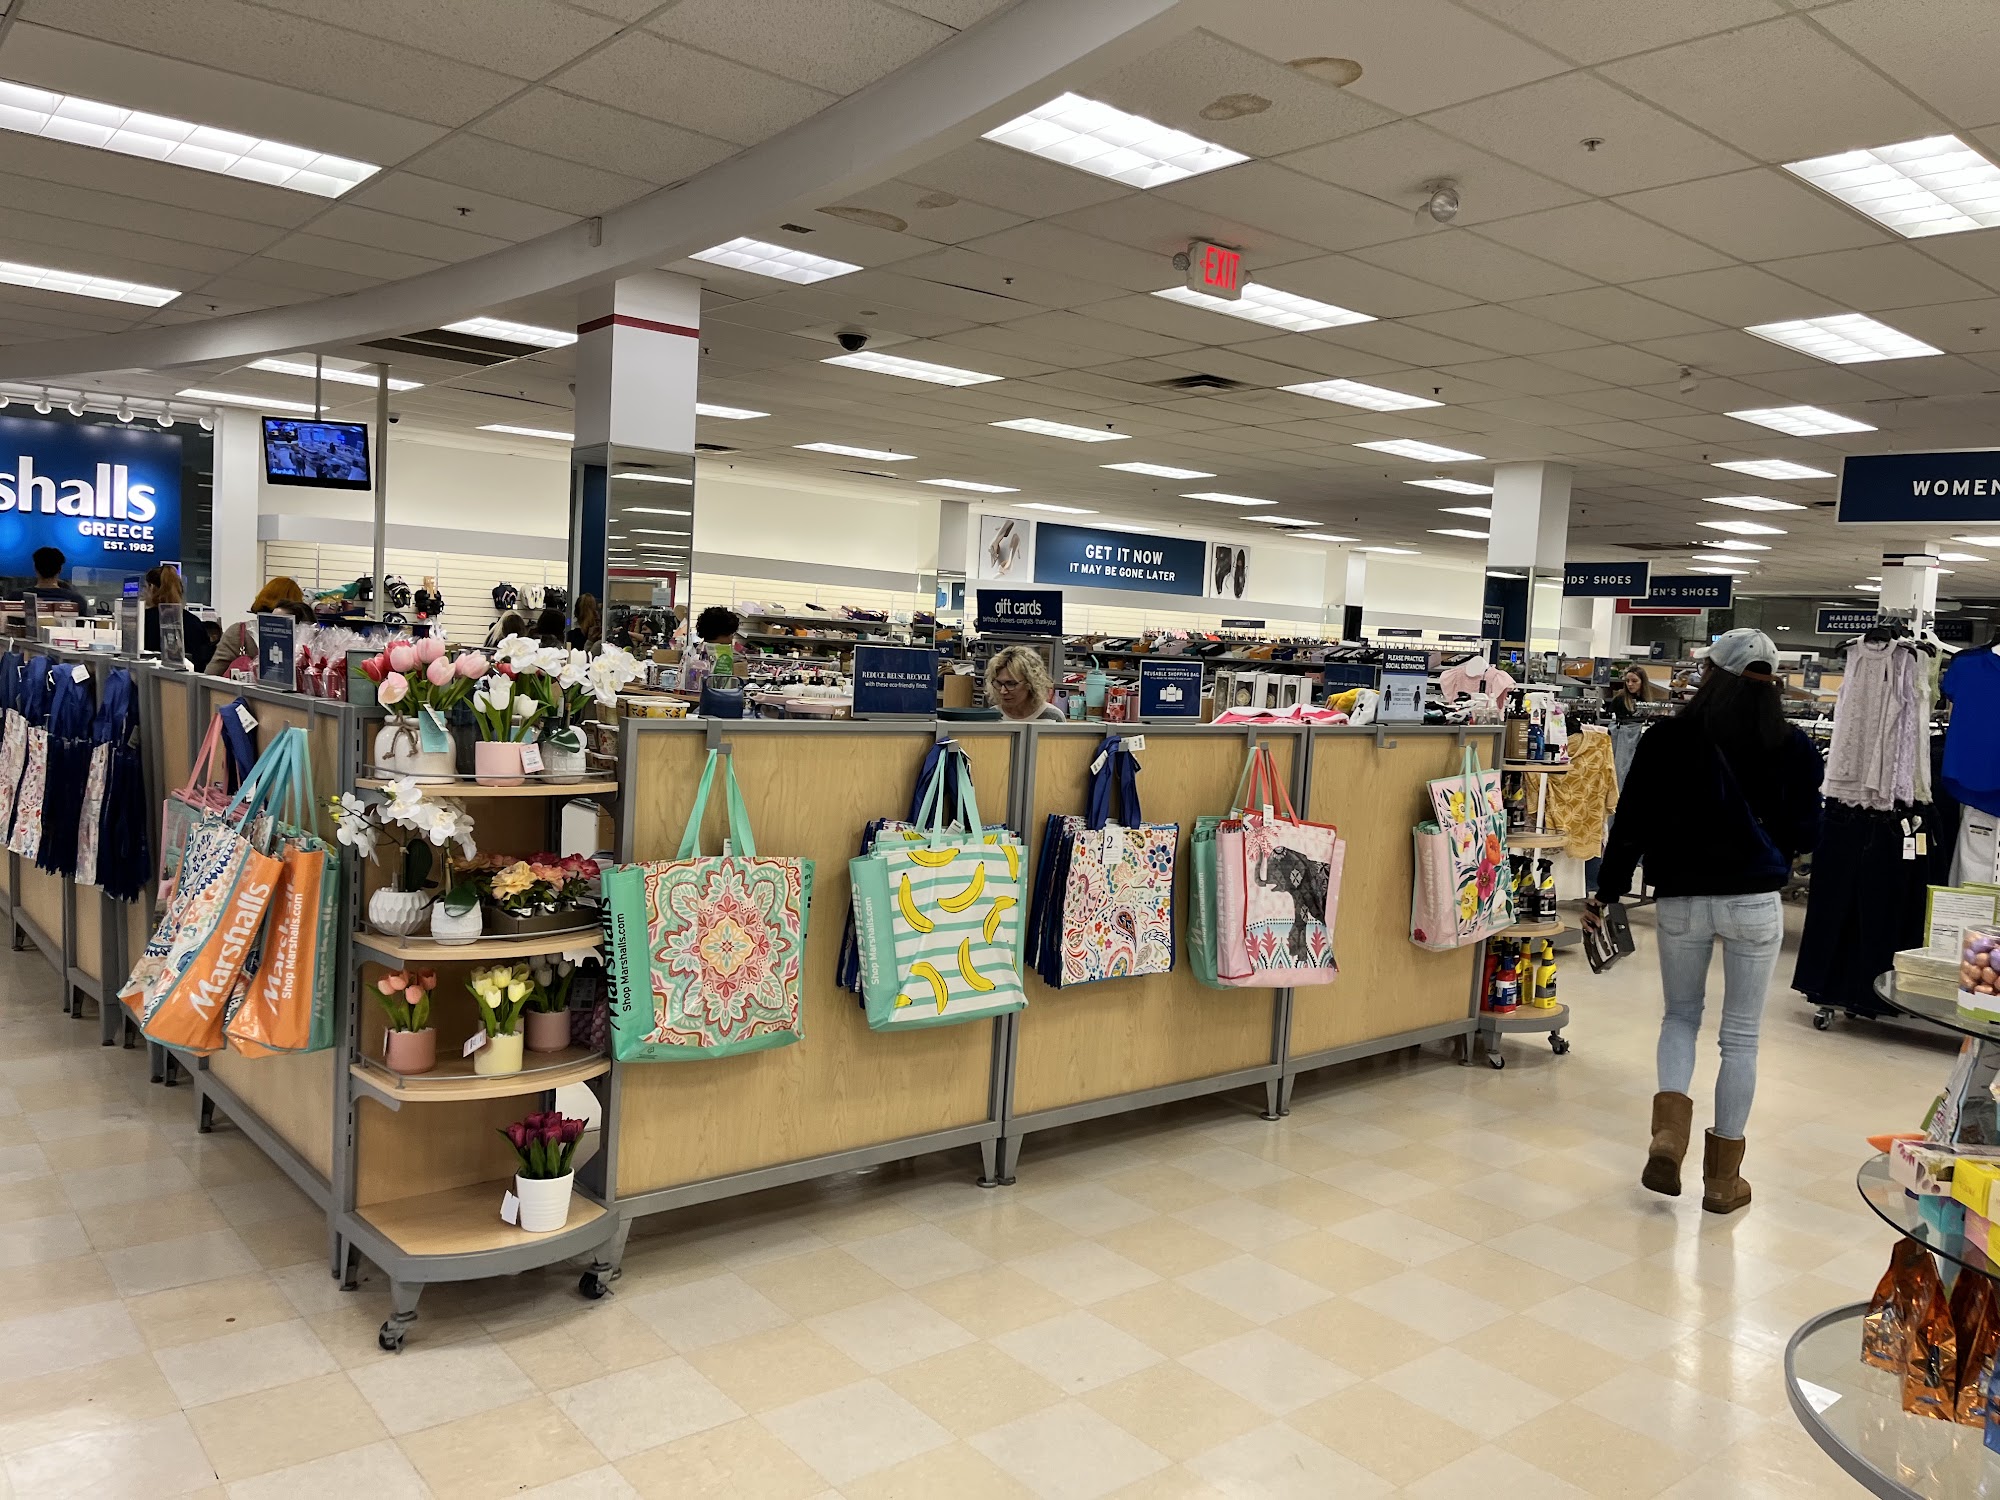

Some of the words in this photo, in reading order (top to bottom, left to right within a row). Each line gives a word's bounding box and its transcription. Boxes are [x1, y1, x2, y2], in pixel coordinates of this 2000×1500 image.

[1204, 245, 1240, 291] EXIT
[78, 521, 154, 540] GREECE
[103, 541, 128, 551] EST.
[129, 542, 155, 553] 1982
[1085, 544, 1112, 560] GET
[1117, 547, 1130, 562] IT
[1133, 549, 1164, 566] NOW
[1069, 562, 1079, 573] IT
[1081, 563, 1102, 575] MAY
[1104, 565, 1117, 576] BE
[1119, 567, 1144, 579] GONE
[1146, 569, 1176, 582] LATER
[1564, 575, 1589, 585] IDS'
[1593, 575, 1632, 585] SHOES
[1649, 587, 1677, 596] EN'S
[1681, 587, 1719, 596] SHOES
[995, 598, 1012, 618] gift
[1013, 599, 1042, 616] cards
[1829, 614, 1877, 622] HANDBAGS
[1387, 654, 1404, 662] PLEASE
[1404, 655, 1425, 663] PRACTICE
[1401, 663, 1426, 671] DISTANCING
[906, 672, 931, 681] RECYCLE
[1106, 835, 1114, 849] 2
[286, 893, 304, 969] Marshalls.com
[864, 896, 878, 961] Marshalls.com
[1228, 921, 1237, 942] Shop
[189, 882, 271, 1021] Marshalls
[263, 876, 296, 1016] Marshall
[616, 913, 630, 984] Marshalls.com
[870, 962, 880, 986] Shop
[281, 972, 296, 1000] Shop
[621, 986, 632, 1012] Shop
